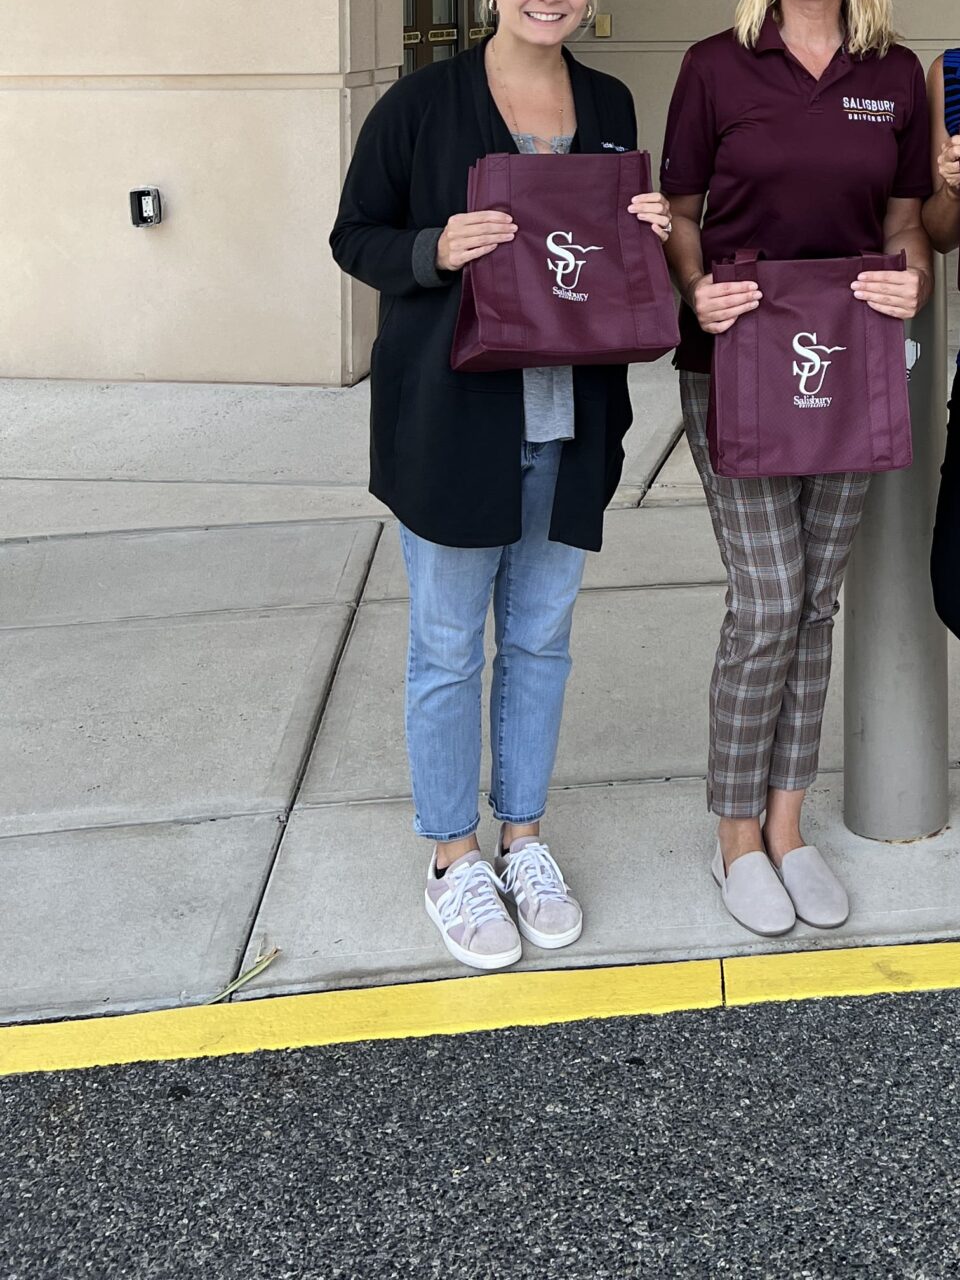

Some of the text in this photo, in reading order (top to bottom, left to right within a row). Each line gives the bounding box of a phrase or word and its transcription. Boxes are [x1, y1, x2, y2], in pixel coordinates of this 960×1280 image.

[842, 96, 895, 113] SALISBURY
[848, 112, 894, 123] UNIVERSITY
[552, 286, 589, 302] Salisbury
[793, 395, 832, 407] Salisbury
